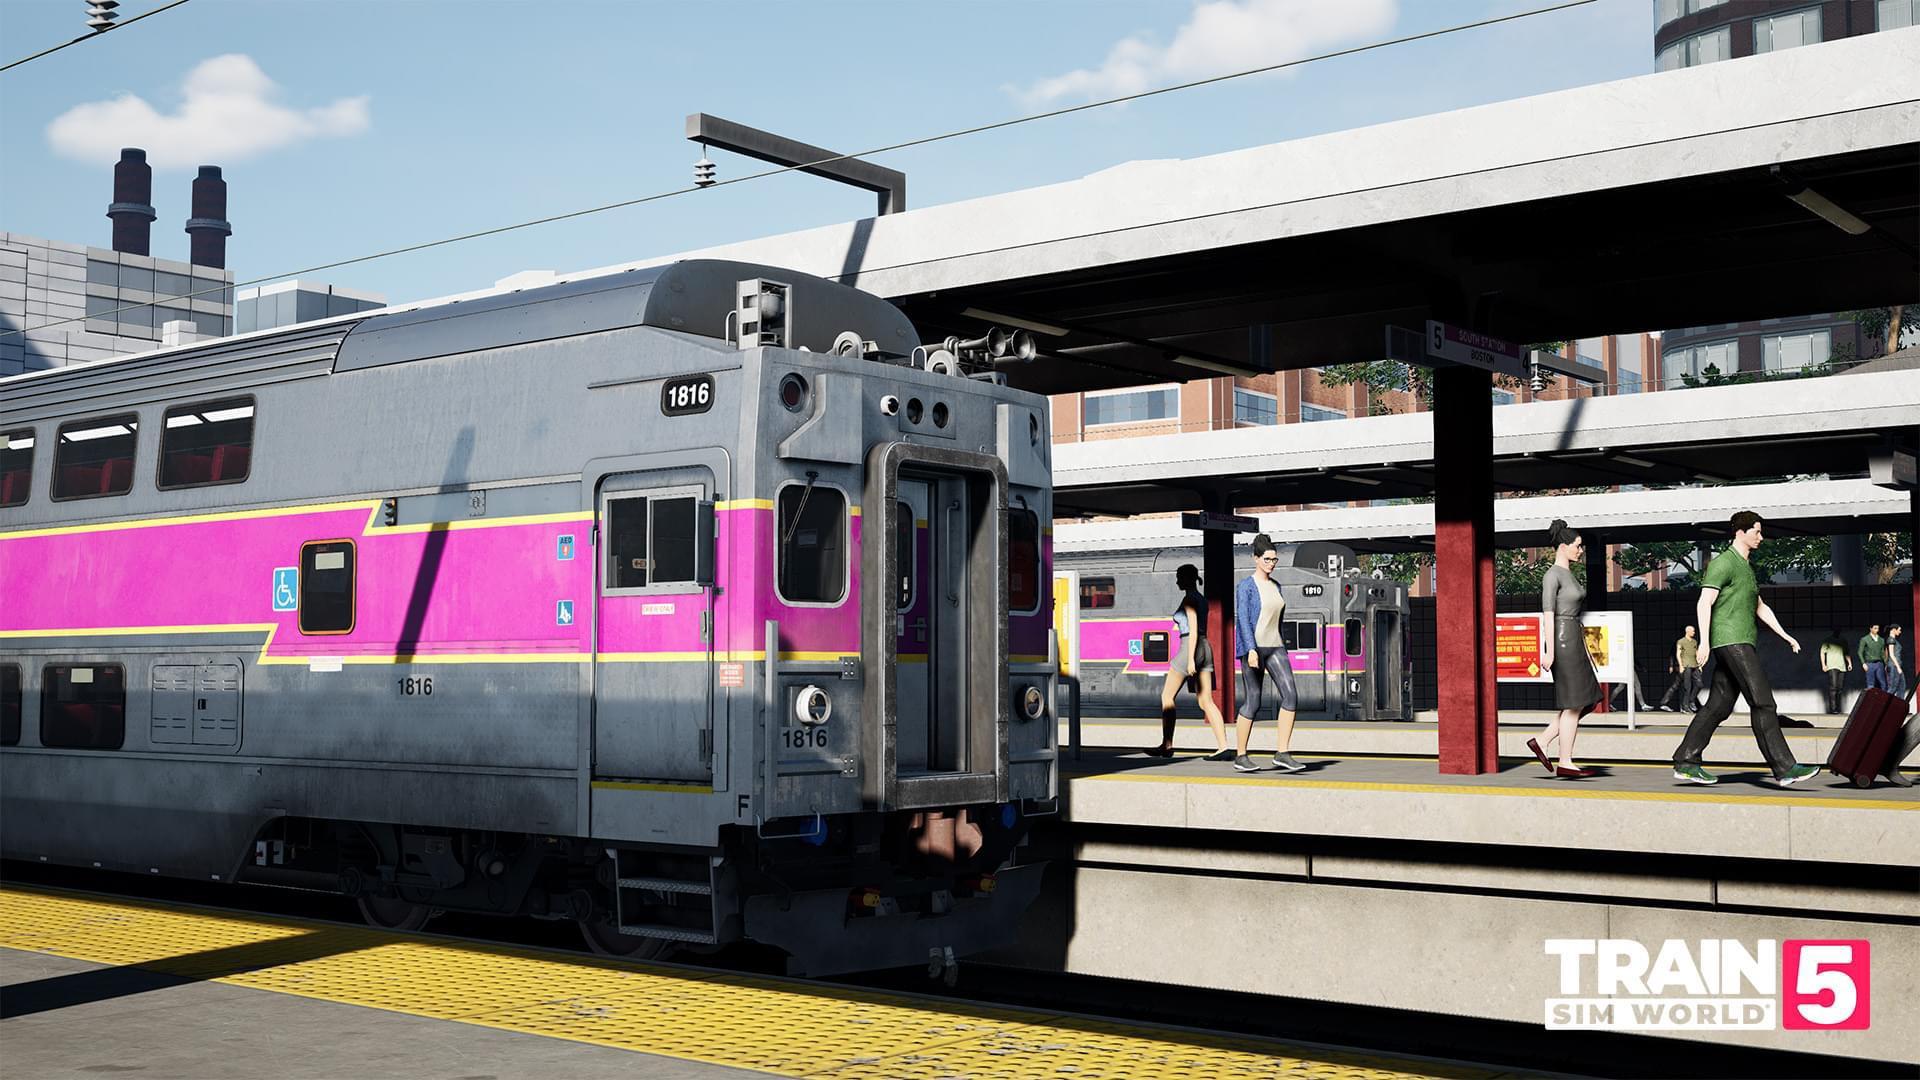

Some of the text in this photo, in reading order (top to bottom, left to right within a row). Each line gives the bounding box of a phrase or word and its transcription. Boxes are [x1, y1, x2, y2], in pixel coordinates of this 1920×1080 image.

[1434, 326, 1441, 349] 5
[1458, 328, 1506, 352] SOUTH STATION
[1471, 350, 1495, 364] BOSTON
[1522, 352, 1529, 373] 4
[668, 382, 709, 407] 1816
[560, 536, 573, 544] AED
[1304, 586, 1322, 595] 1810
[398, 678, 433, 695] 1816
[782, 730, 828, 748] 1816
[738, 795, 750, 818] F
